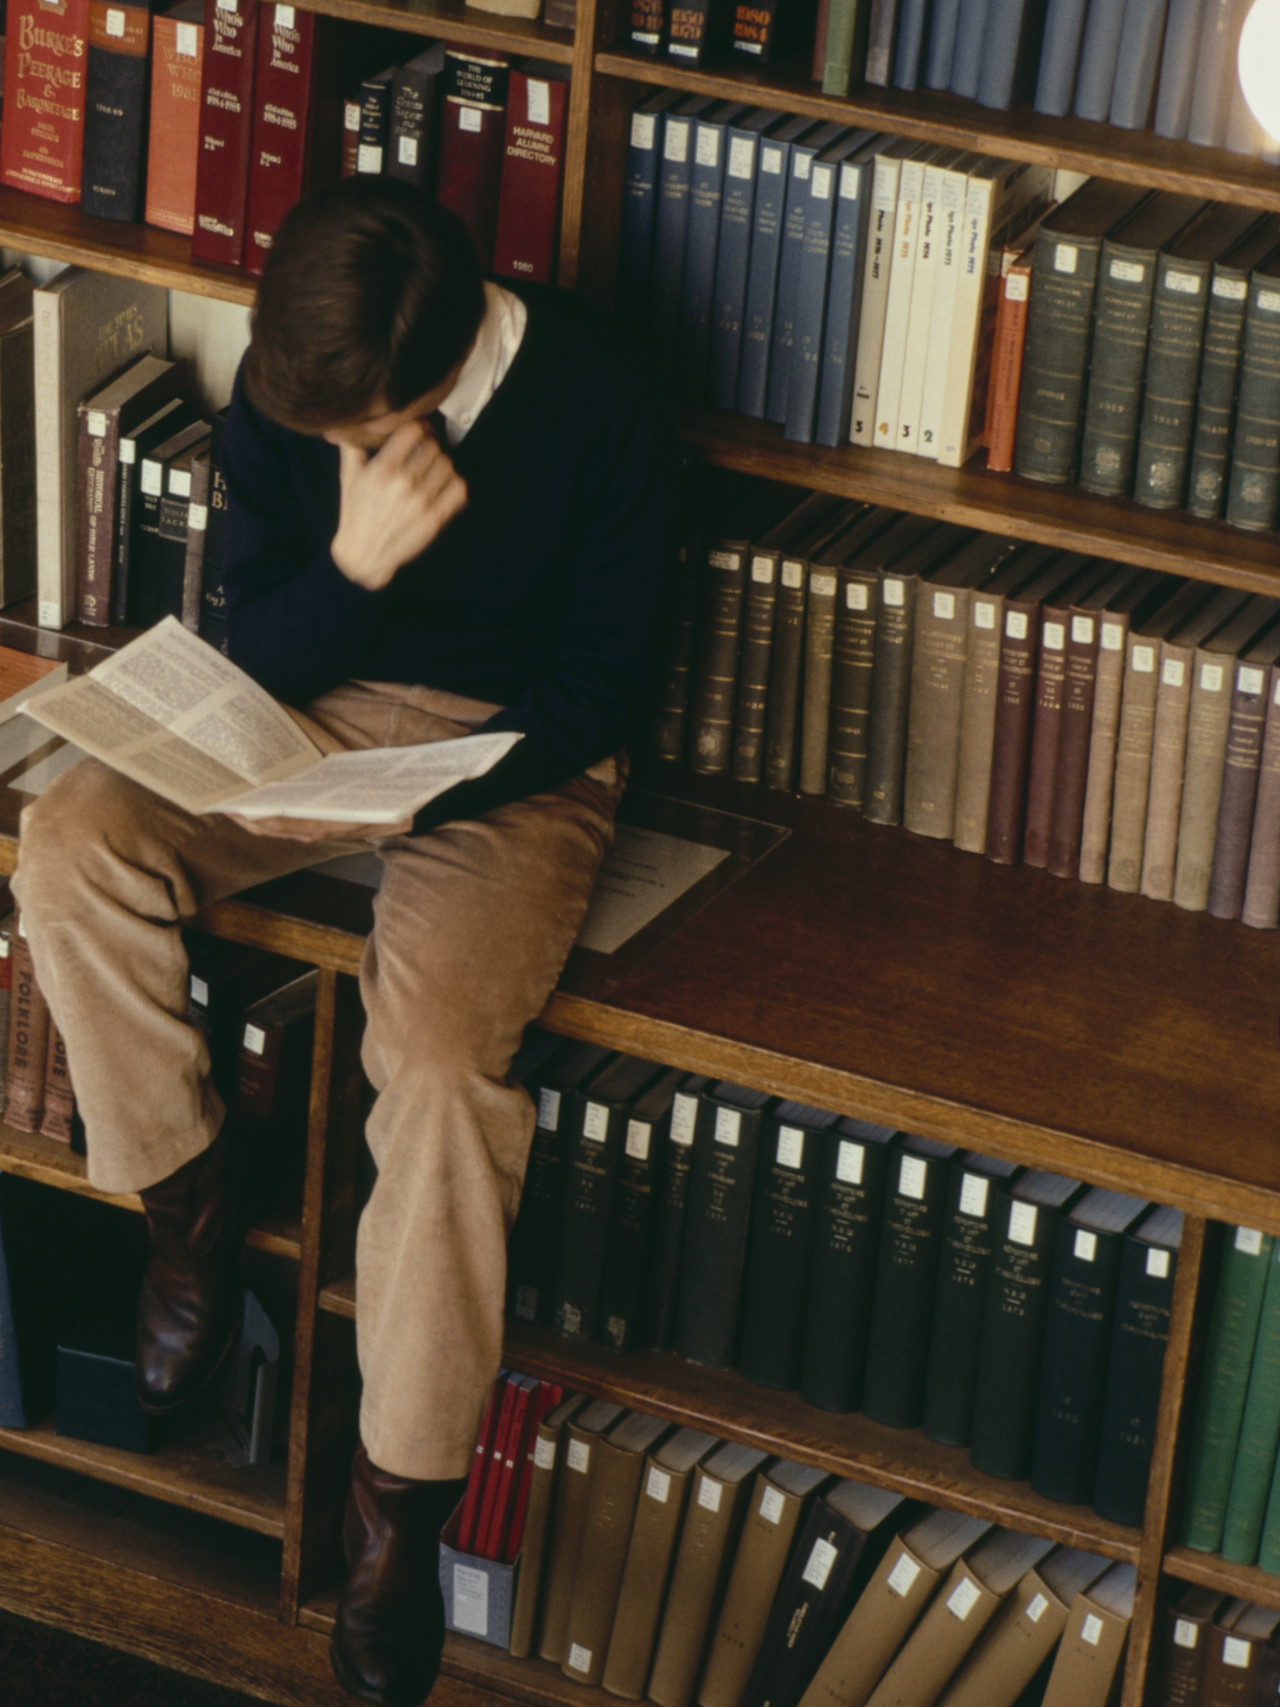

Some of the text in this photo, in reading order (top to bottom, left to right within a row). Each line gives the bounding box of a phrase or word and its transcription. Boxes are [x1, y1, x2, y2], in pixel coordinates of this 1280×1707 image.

[171, 82, 197, 101] 1981
[513, 126, 554, 144] HARVARD
[516, 137, 551, 153] ALUMNI
[507, 146, 557, 166] DIRECTORY
[878, 422, 888, 435] 4
[924, 430, 933, 443] 2
[14, 971, 32, 1069] FOLKLORE
